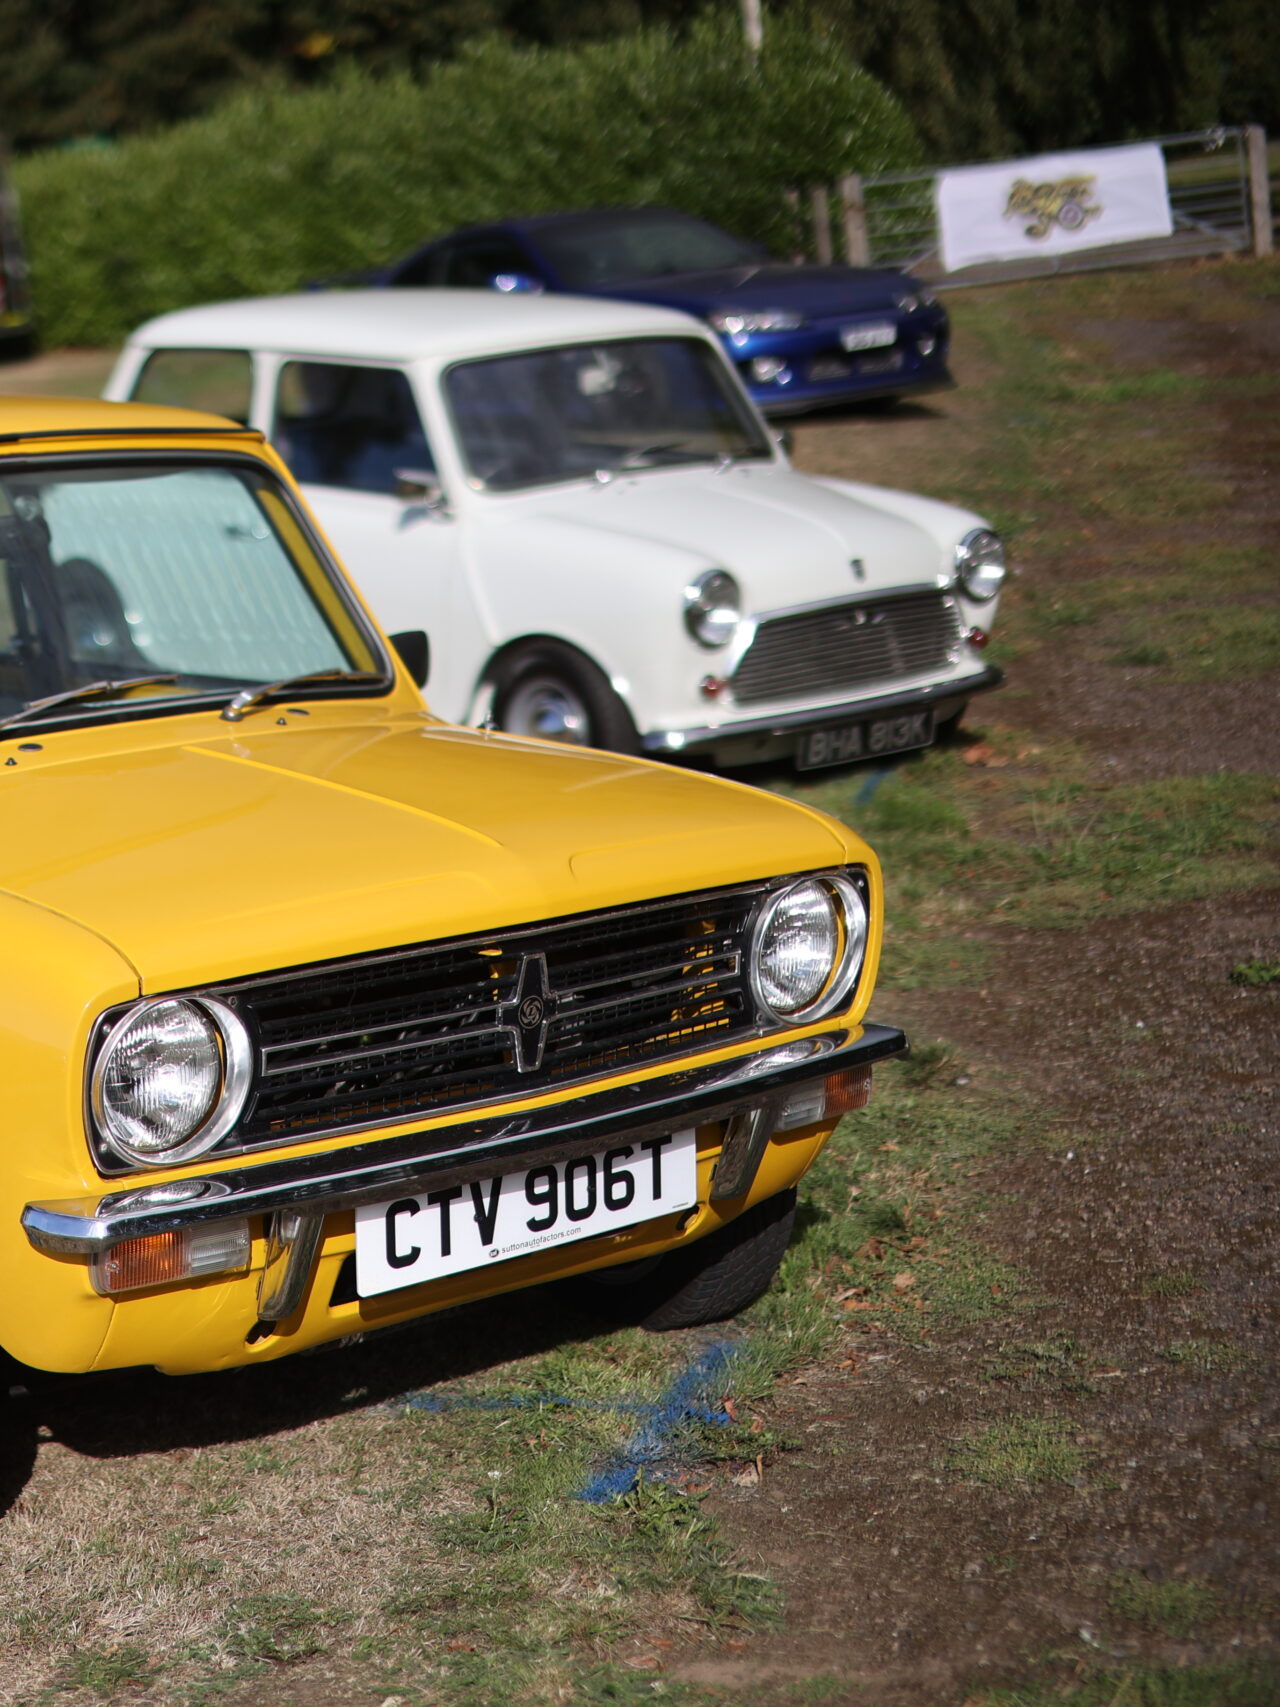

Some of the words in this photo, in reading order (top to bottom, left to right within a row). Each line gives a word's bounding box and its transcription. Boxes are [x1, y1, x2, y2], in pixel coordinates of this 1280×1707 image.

[385, 1176, 503, 1269] CTV
[525, 1134, 672, 1232] 906T
[501, 1226, 581, 1254] suttonautofactors.com
